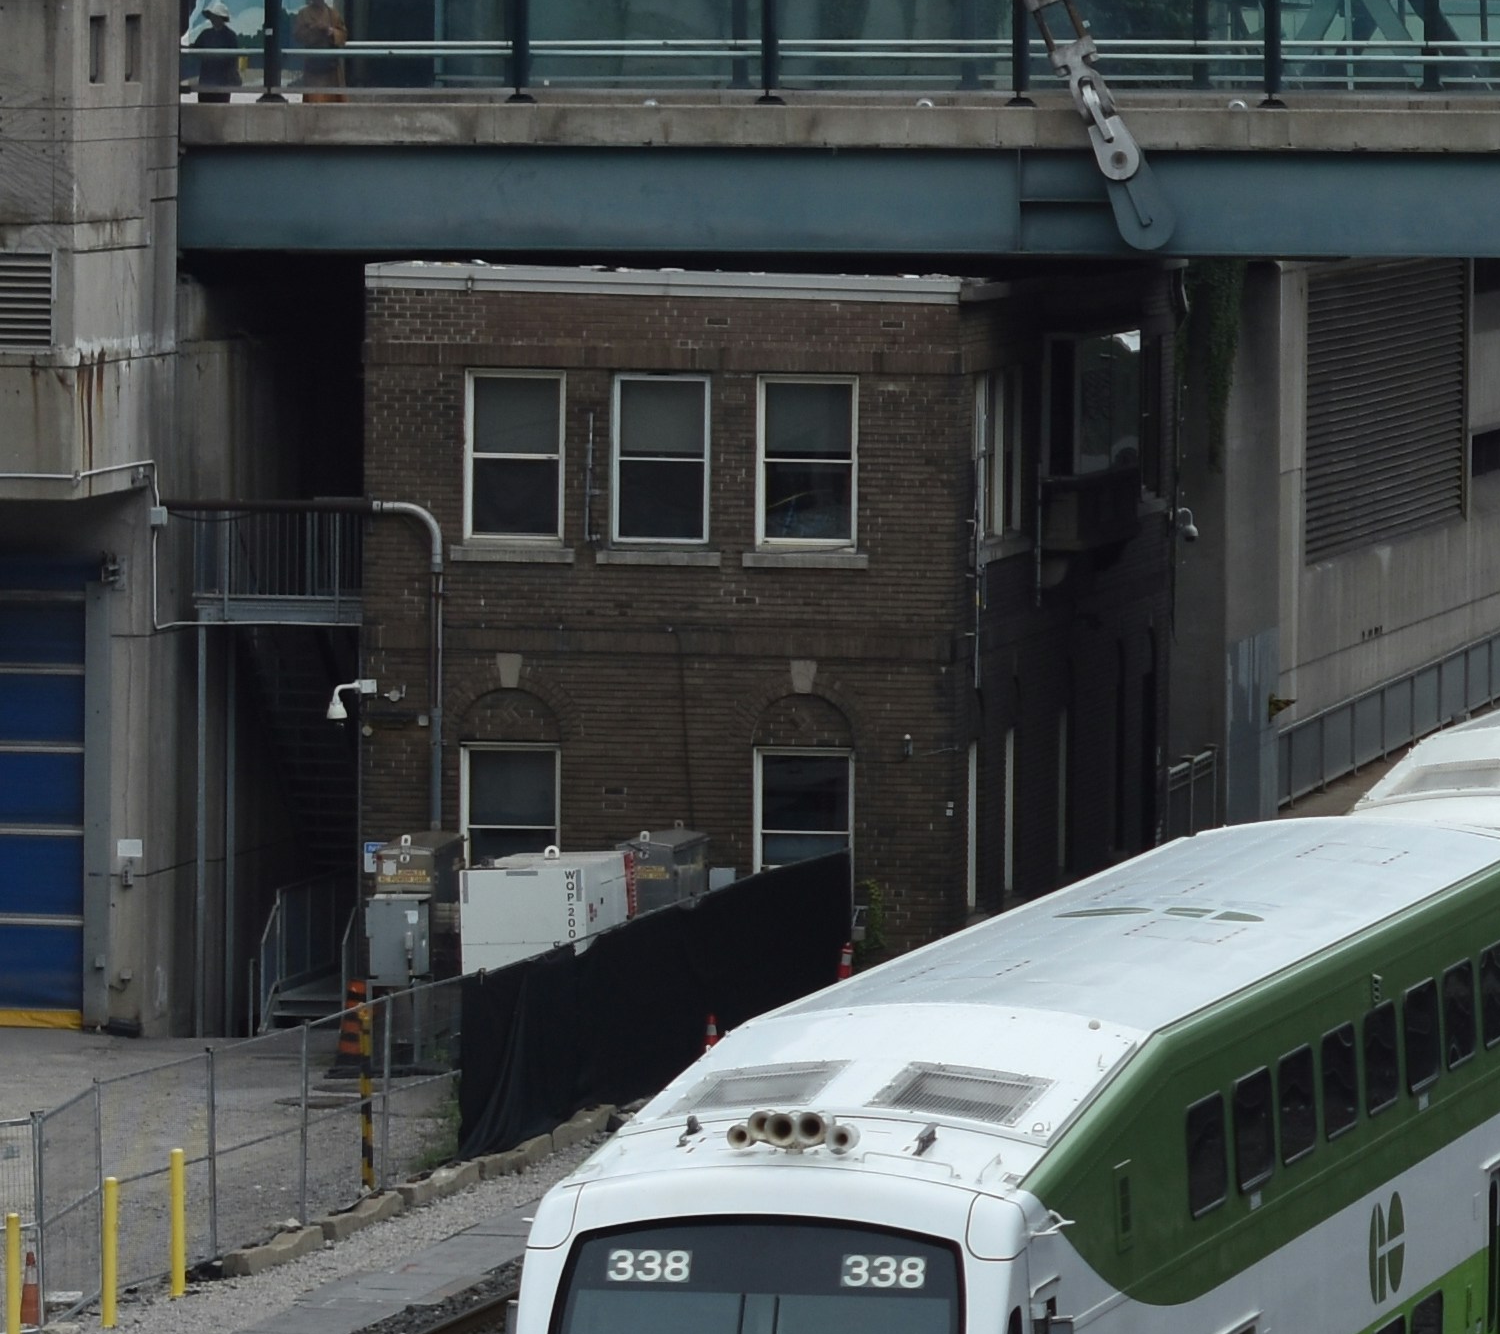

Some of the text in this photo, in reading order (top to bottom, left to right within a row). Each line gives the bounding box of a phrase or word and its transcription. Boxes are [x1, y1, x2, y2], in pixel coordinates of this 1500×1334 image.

[564, 870, 577, 939] WQP-200
[608, 1250, 925, 1288] 338 338
[1369, 1191, 1405, 1305] GO
